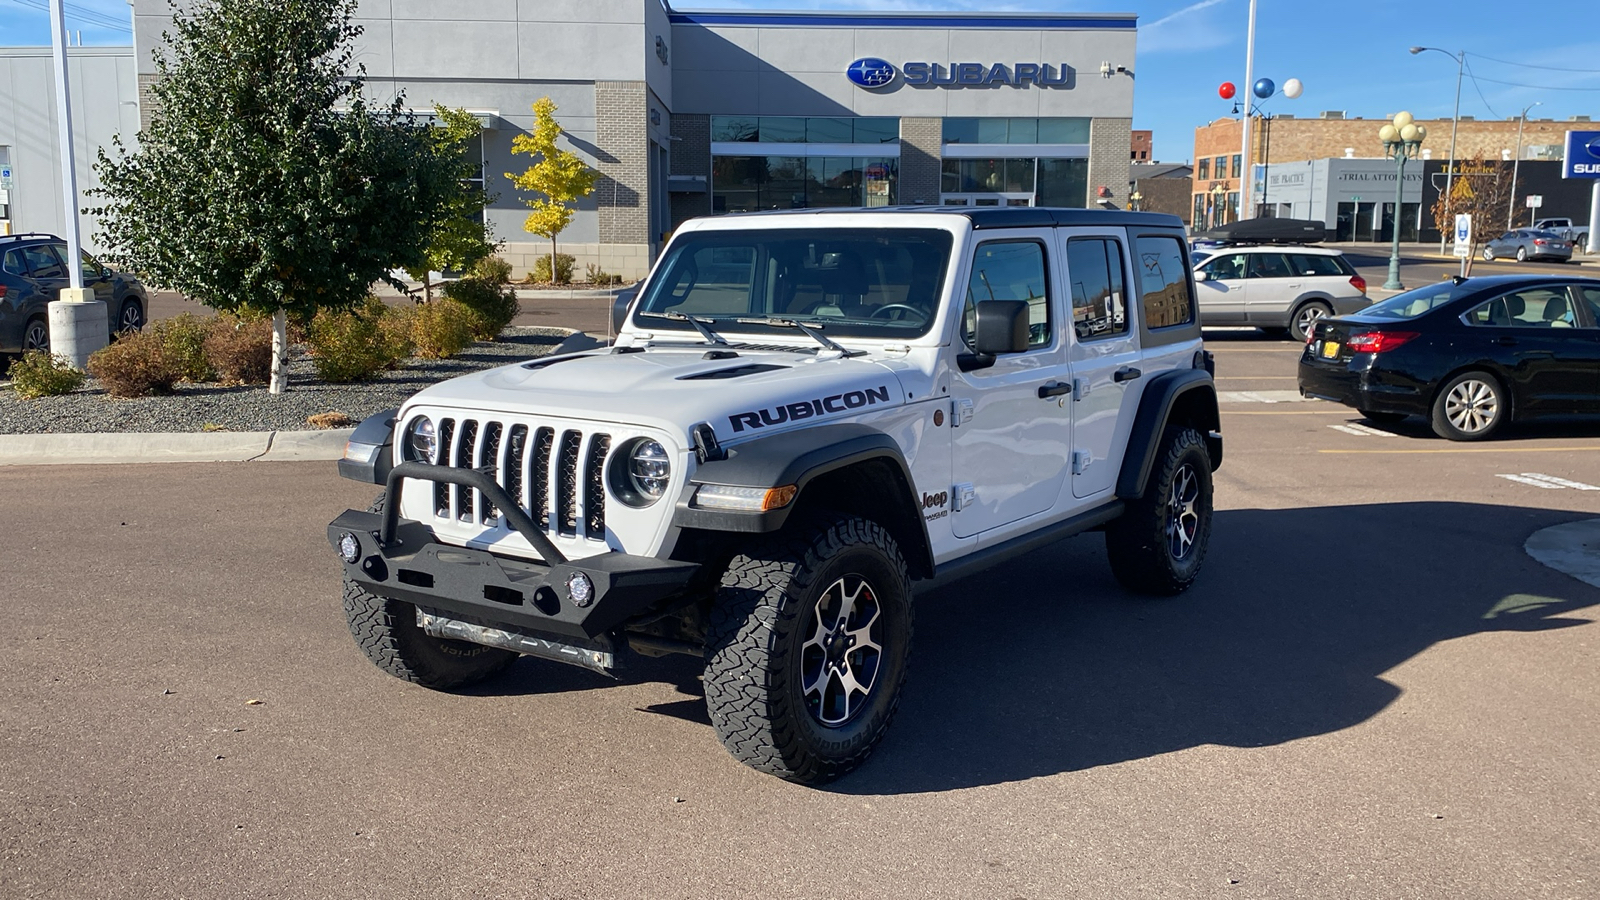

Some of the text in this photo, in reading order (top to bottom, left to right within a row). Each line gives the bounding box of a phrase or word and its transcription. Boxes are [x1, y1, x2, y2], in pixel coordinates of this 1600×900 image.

[903, 62, 1068, 85] SUBARU
[1270, 175, 1279, 184] THE
[1343, 173, 1423, 181] TRIAL ATTONEYS
[728, 385, 889, 433] RUBICON
[921, 491, 948, 510] Jeep
